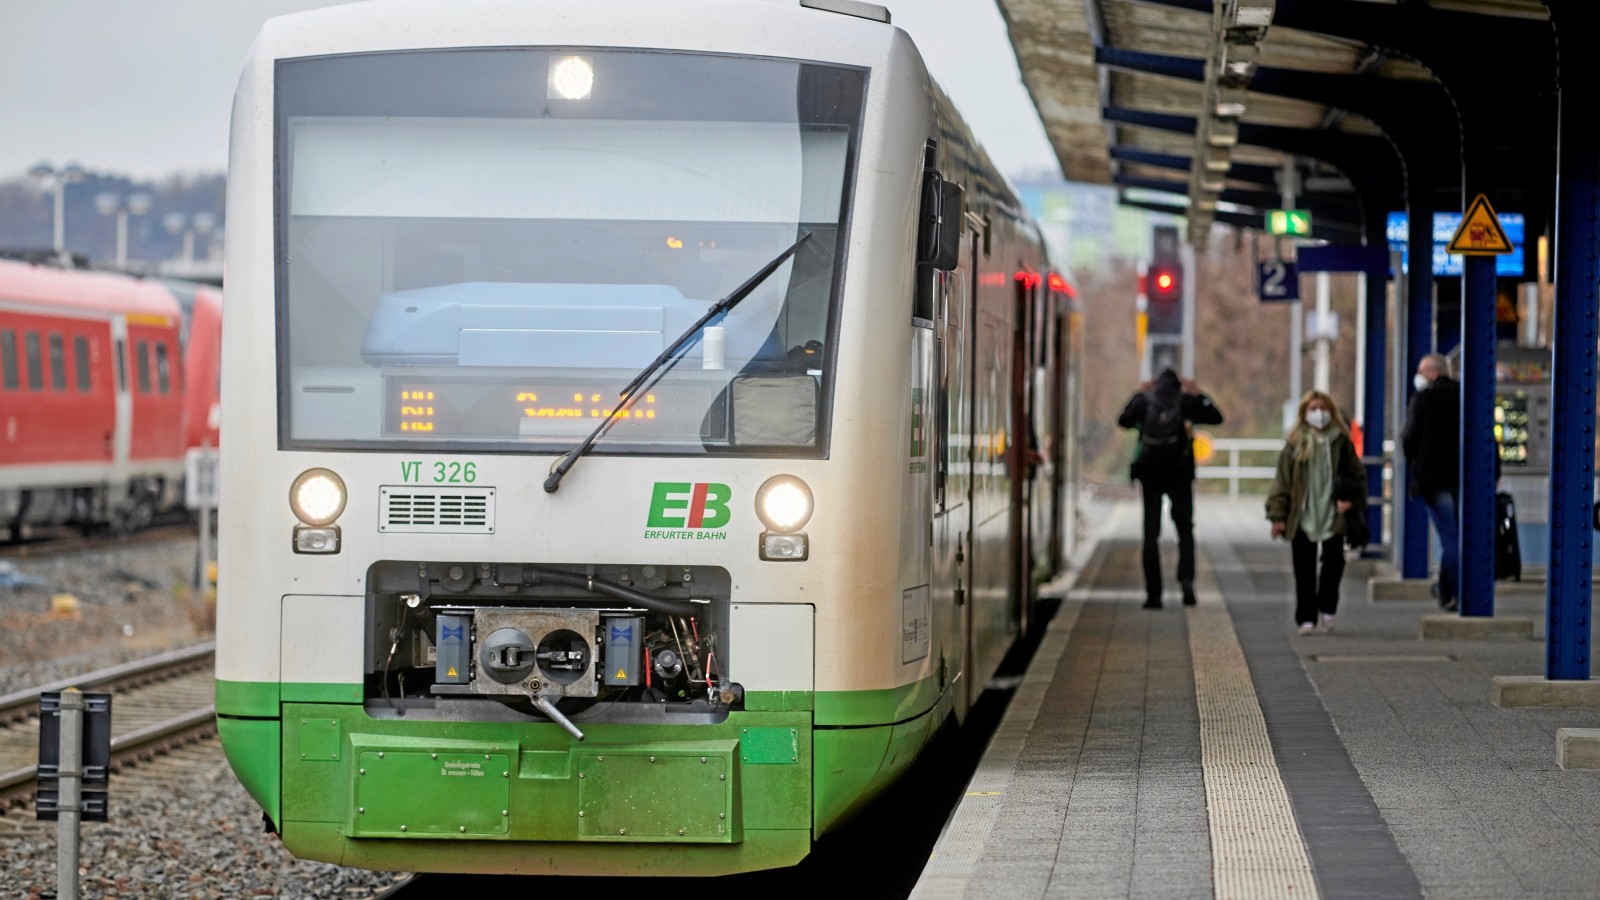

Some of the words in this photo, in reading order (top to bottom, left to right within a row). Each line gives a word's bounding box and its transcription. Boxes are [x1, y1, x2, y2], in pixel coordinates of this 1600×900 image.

[1262, 262, 1286, 296] 2
[401, 461, 422, 482] VT
[433, 461, 476, 483] 326
[644, 530, 693, 540] ERFURTER
[696, 531, 727, 540] BAHN
